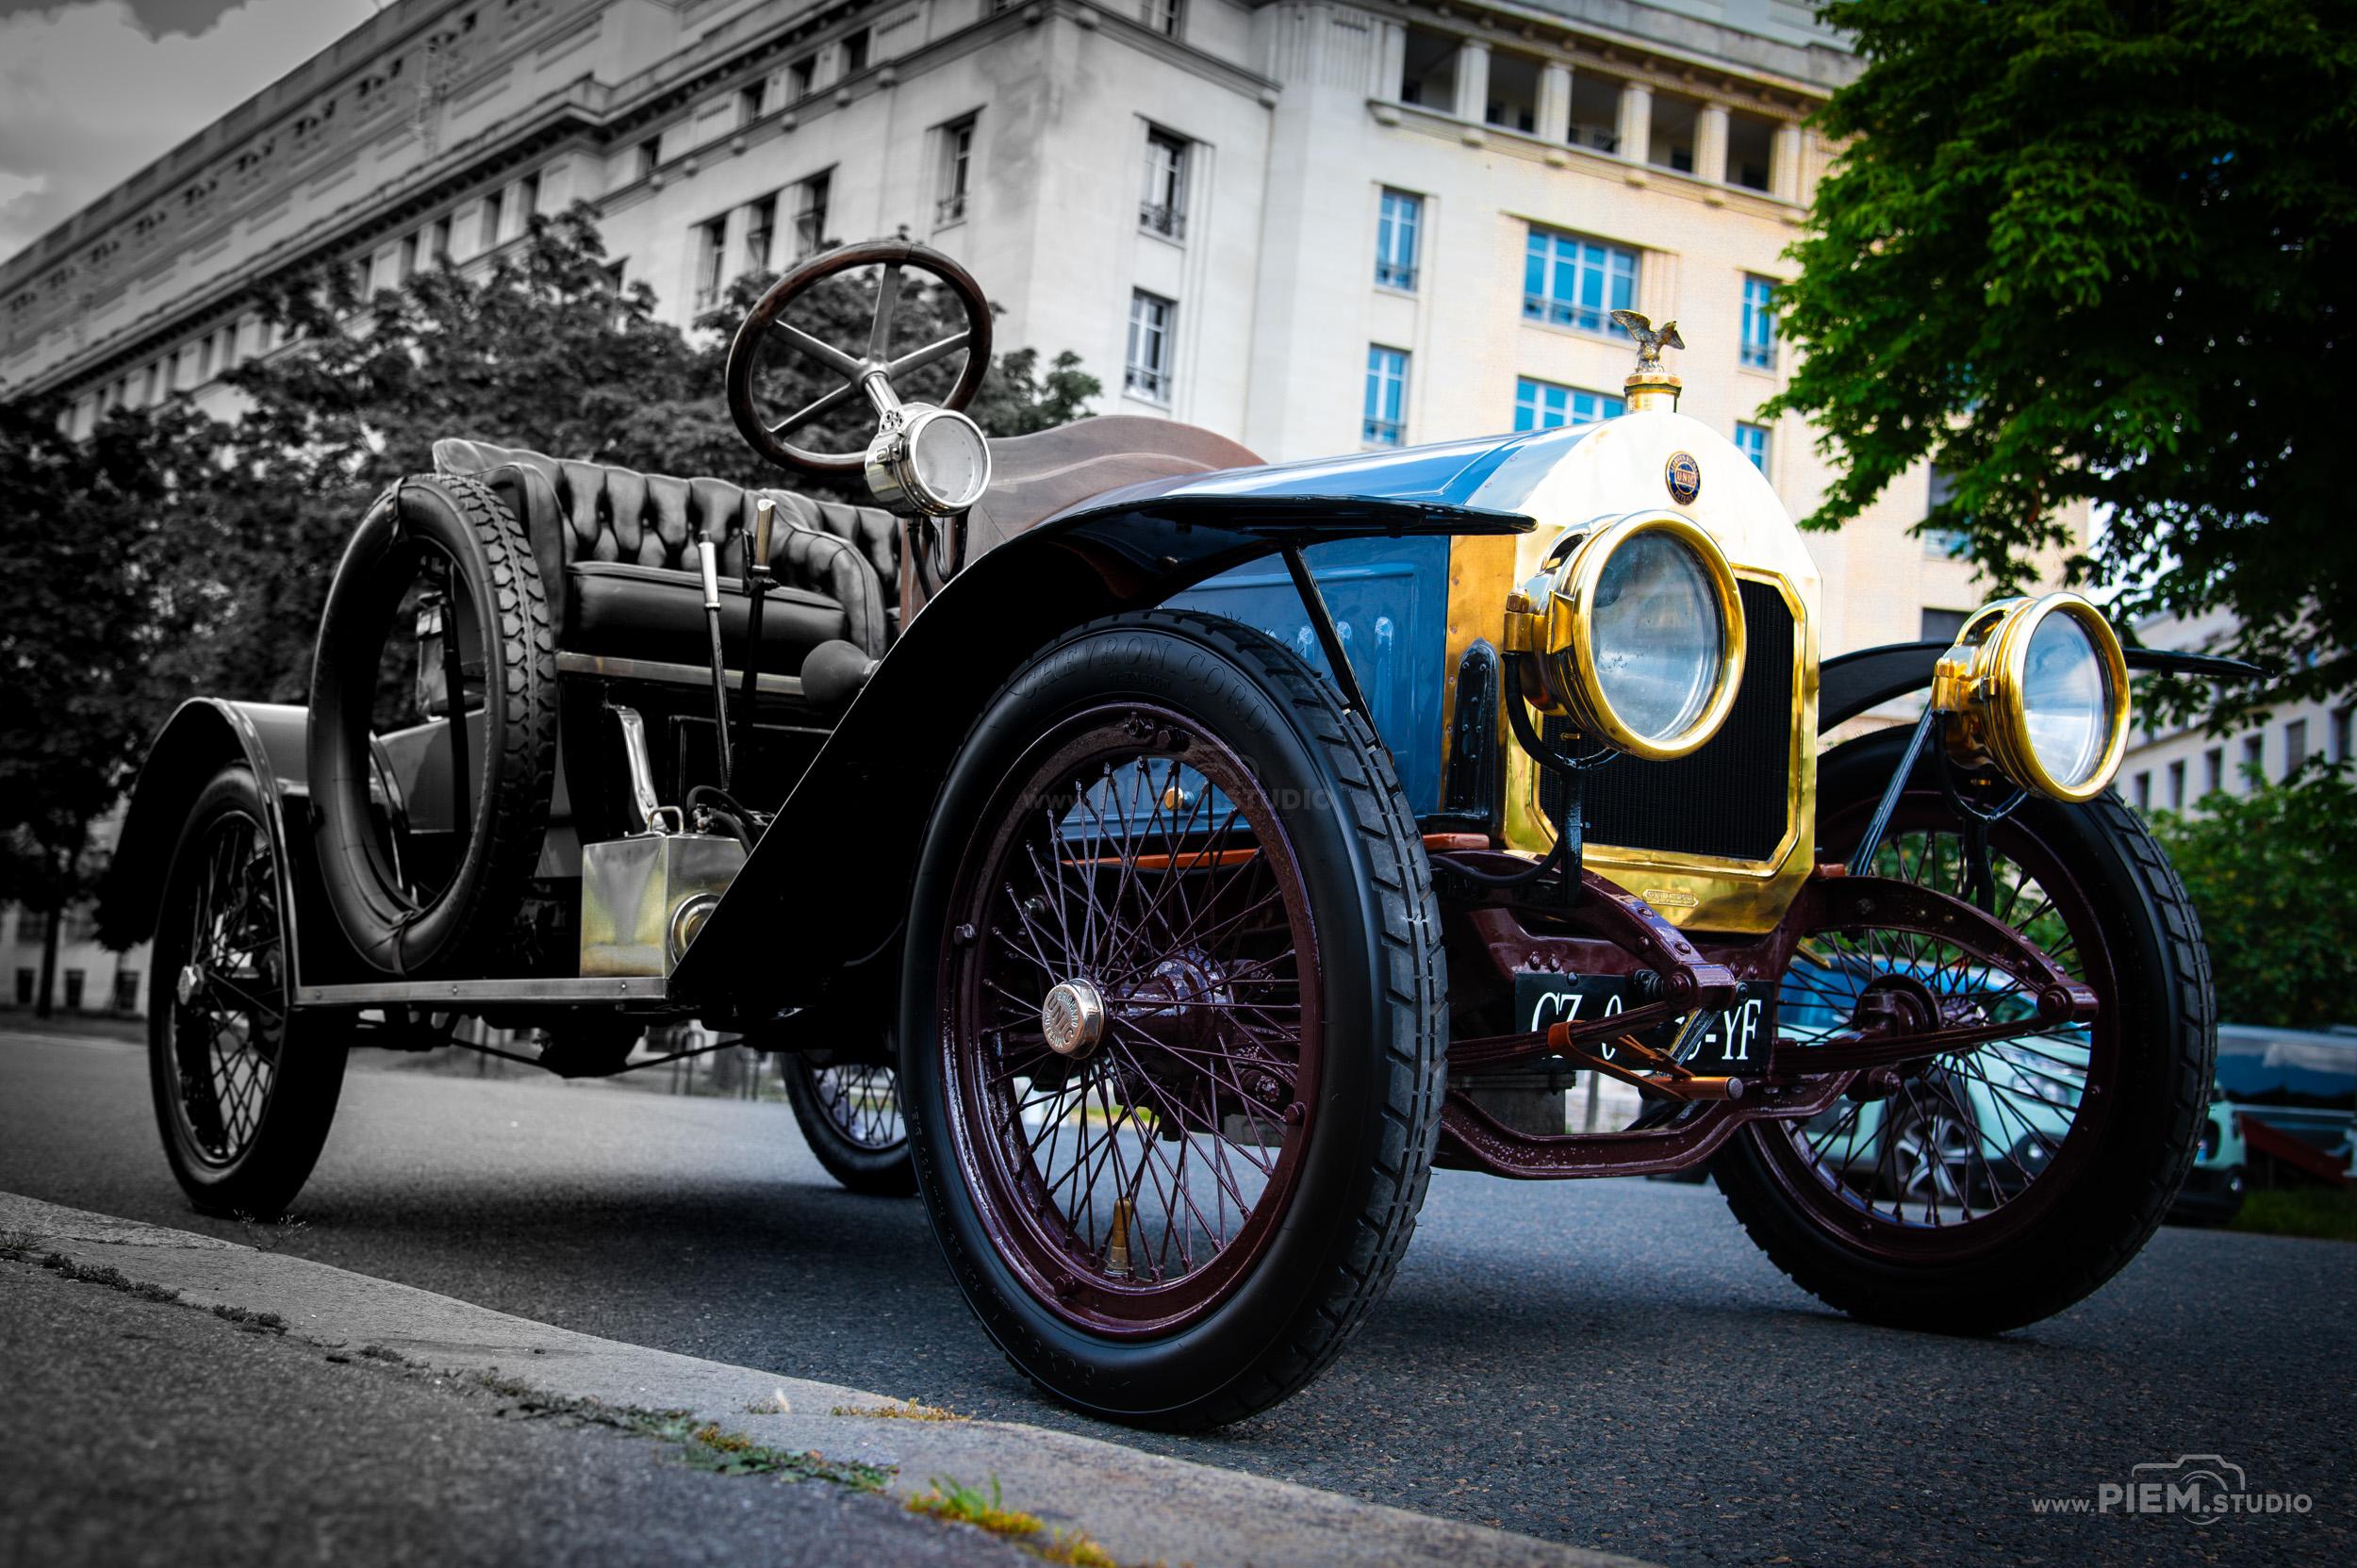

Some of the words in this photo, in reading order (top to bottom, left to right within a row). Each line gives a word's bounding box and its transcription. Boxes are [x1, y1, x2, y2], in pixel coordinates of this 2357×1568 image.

[1675, 470, 1695, 487] UNIC
[1024, 635, 1173, 699] CHEVRON
[1185, 652, 1269, 734] CORD
[1047, 993, 1074, 1044] UNIC
